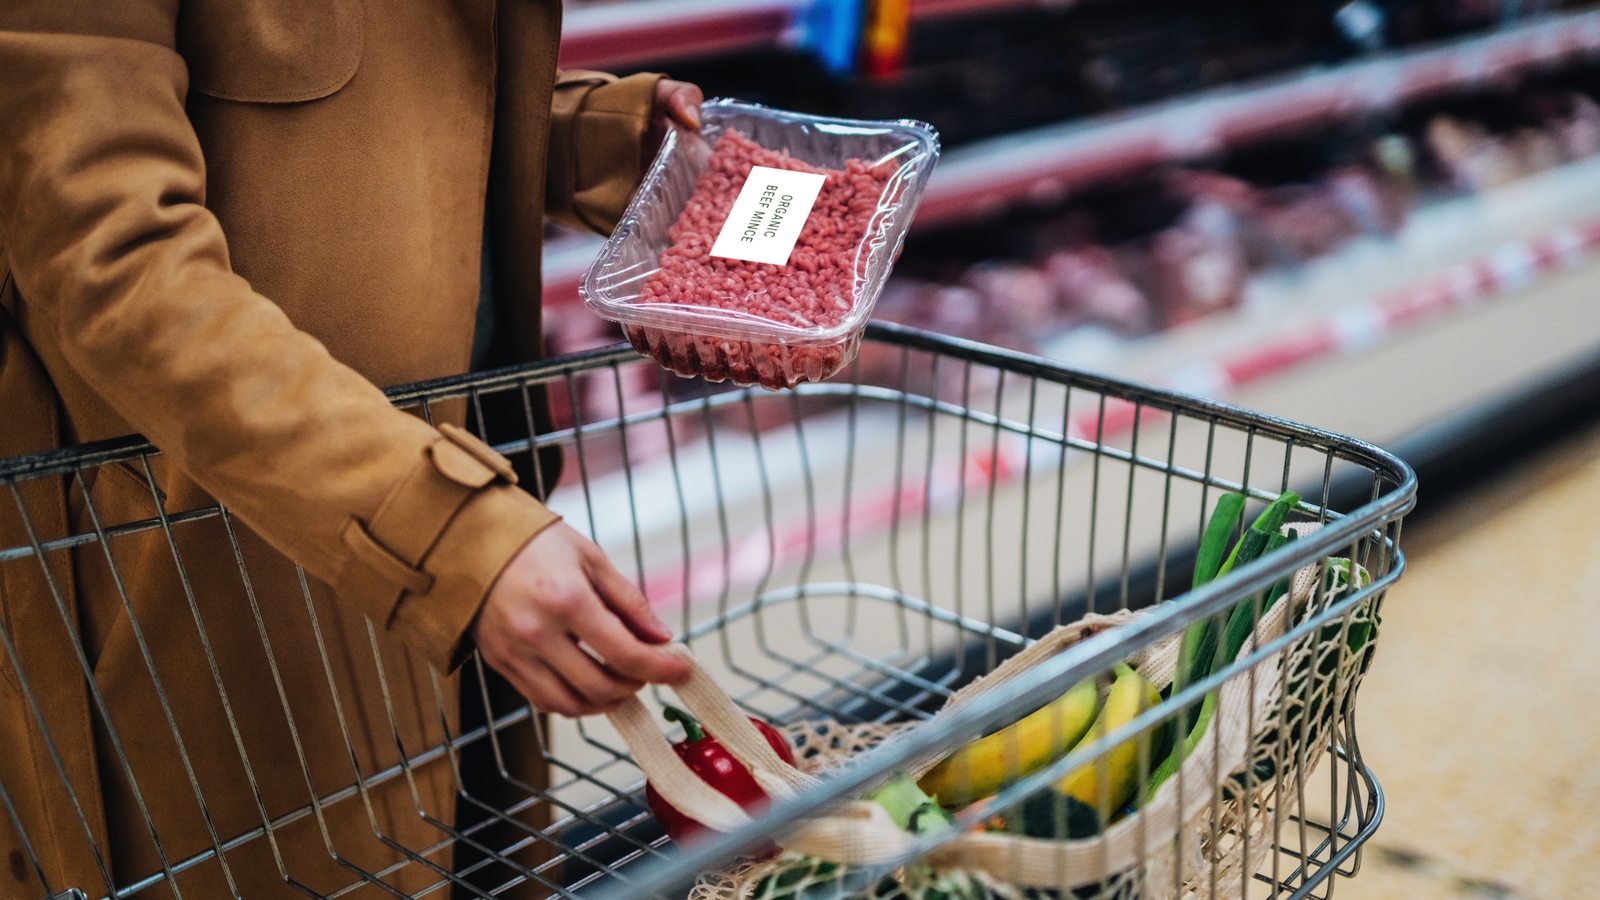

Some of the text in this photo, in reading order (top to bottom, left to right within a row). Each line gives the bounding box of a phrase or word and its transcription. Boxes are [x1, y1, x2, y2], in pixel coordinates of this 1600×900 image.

[740, 185, 778, 243] BEEF MINCE
[763, 194, 793, 238] ORGANIC
